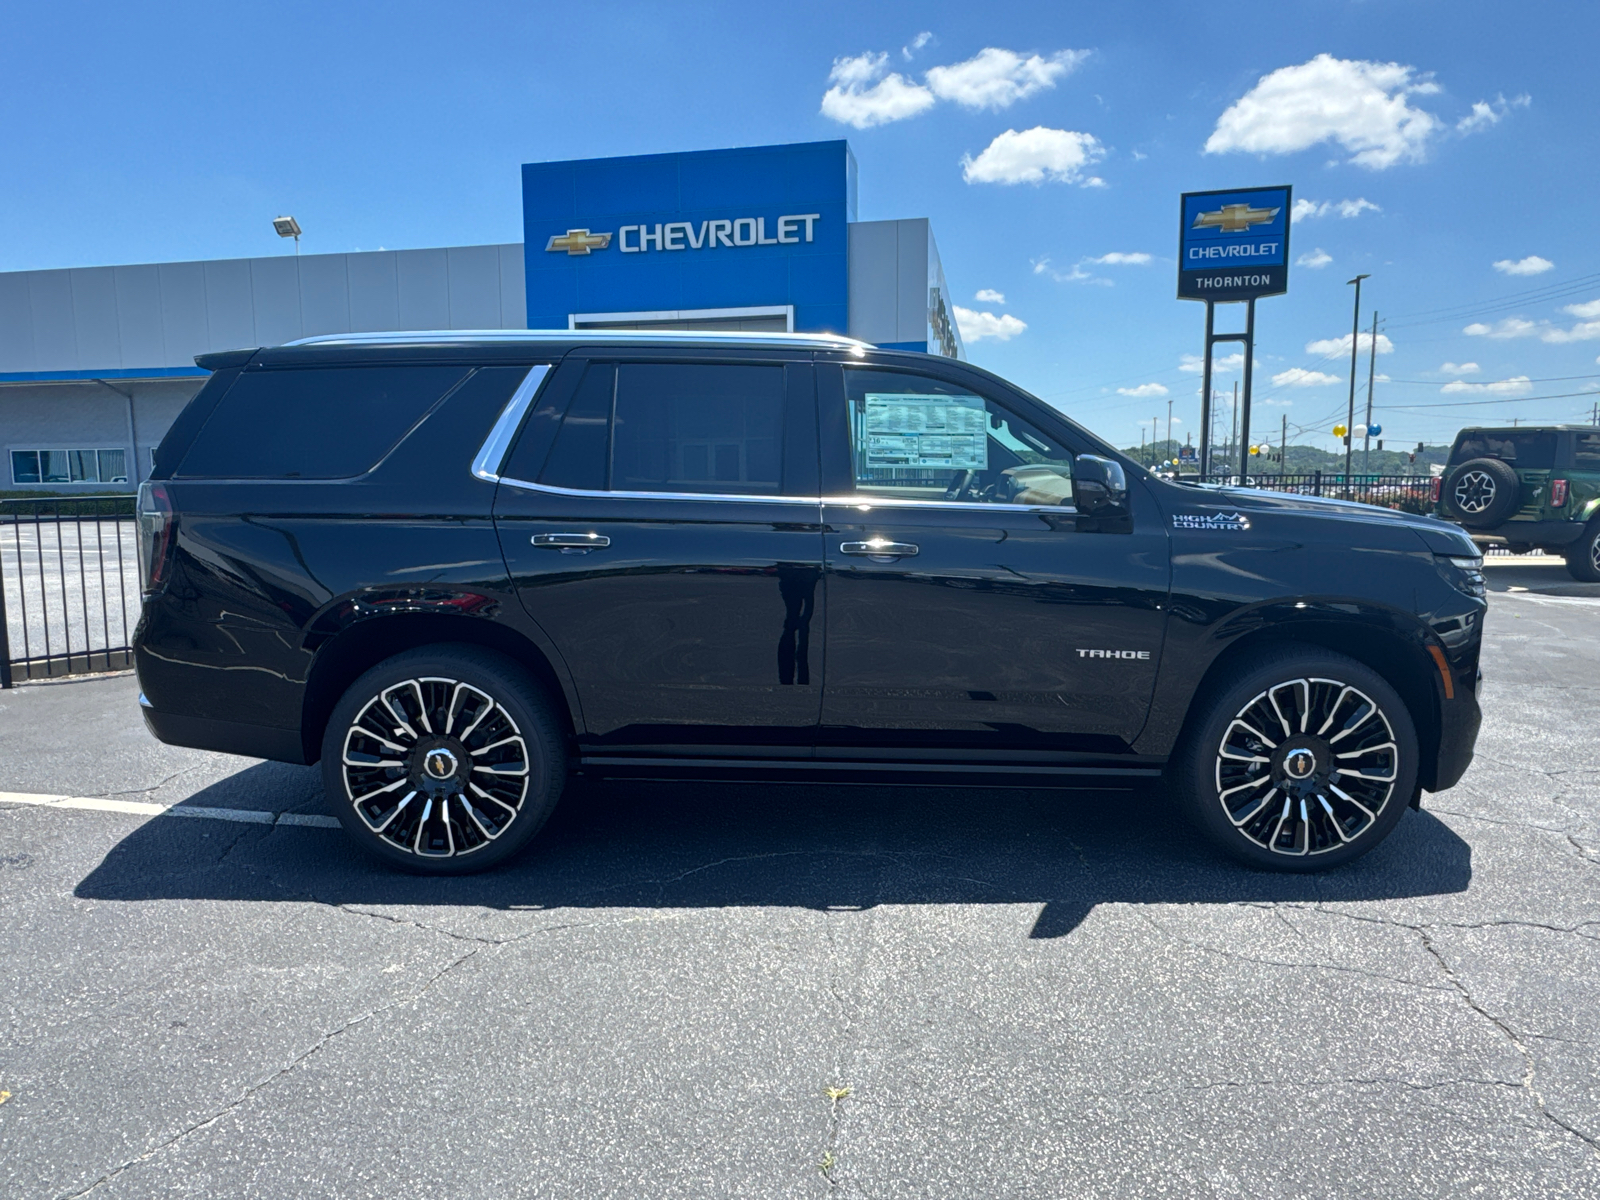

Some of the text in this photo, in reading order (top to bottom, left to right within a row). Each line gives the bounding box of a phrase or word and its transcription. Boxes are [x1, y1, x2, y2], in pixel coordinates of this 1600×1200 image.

[619, 213, 820, 253] CHEVROLET
[1189, 243, 1278, 259] CHEVROLET
[1196, 274, 1270, 288] THORNTON
[1172, 514, 1212, 522] HIGH
[1173, 521, 1250, 530] COUNTRY
[1075, 648, 1150, 660] TAHOE
